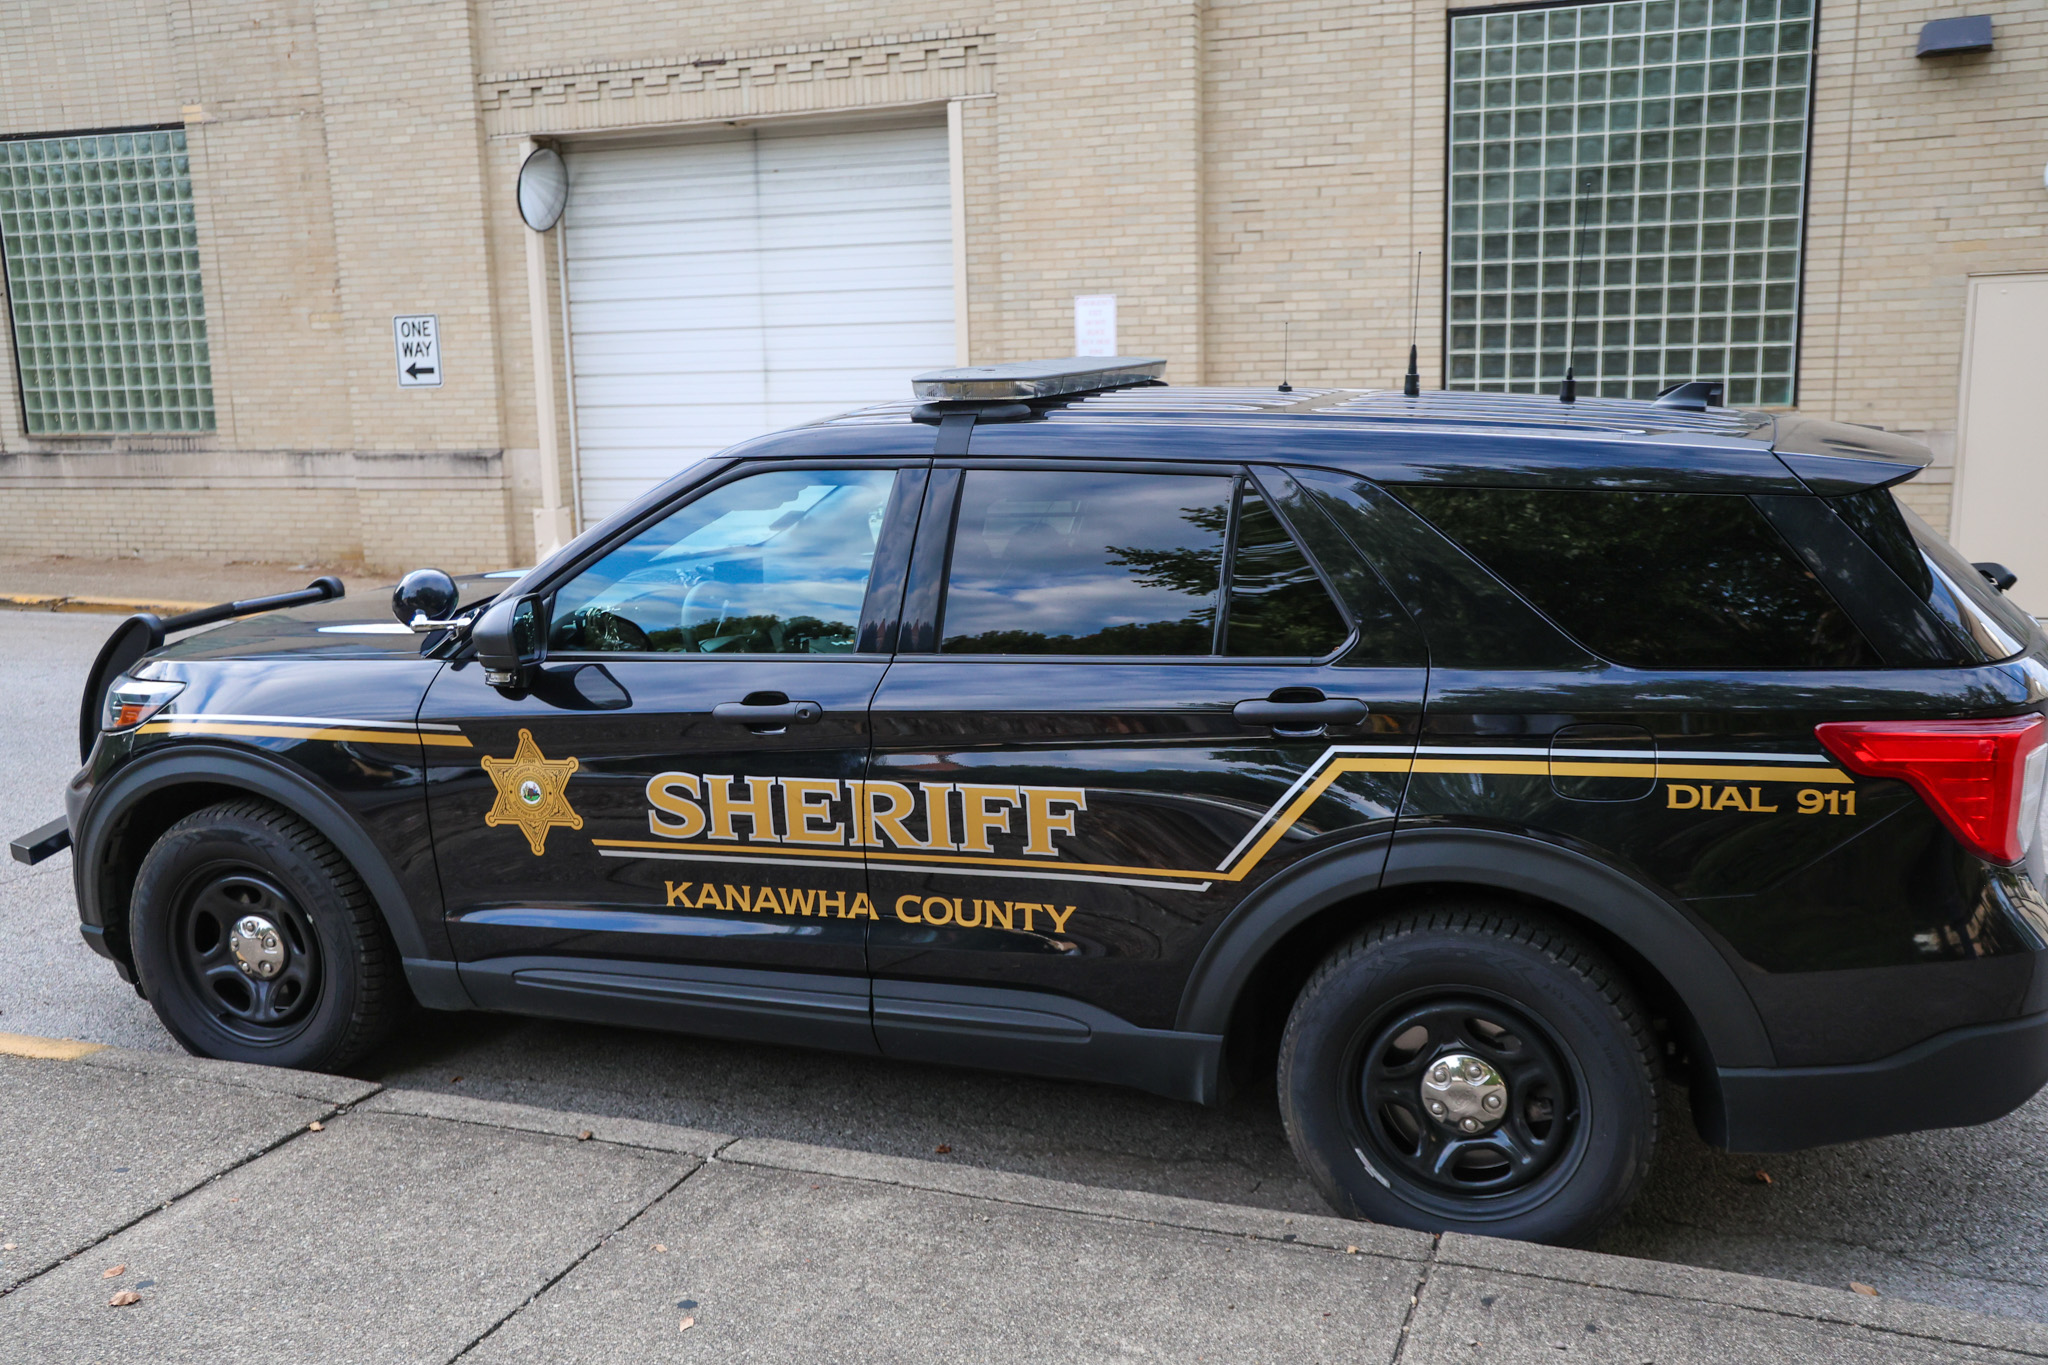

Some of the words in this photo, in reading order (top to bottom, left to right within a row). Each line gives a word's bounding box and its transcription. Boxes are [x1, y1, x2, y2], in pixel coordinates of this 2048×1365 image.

[401, 320, 431, 338] ONE
[402, 340, 432, 358] WAY
[533, 768, 550, 786] COUNTY
[1666, 784, 1778, 813] DIAL
[1796, 788, 1857, 816] 911
[646, 771, 1088, 856] SHERIFF
[664, 880, 880, 921] KANAWHA
[895, 894, 1077, 934] COUNTY
